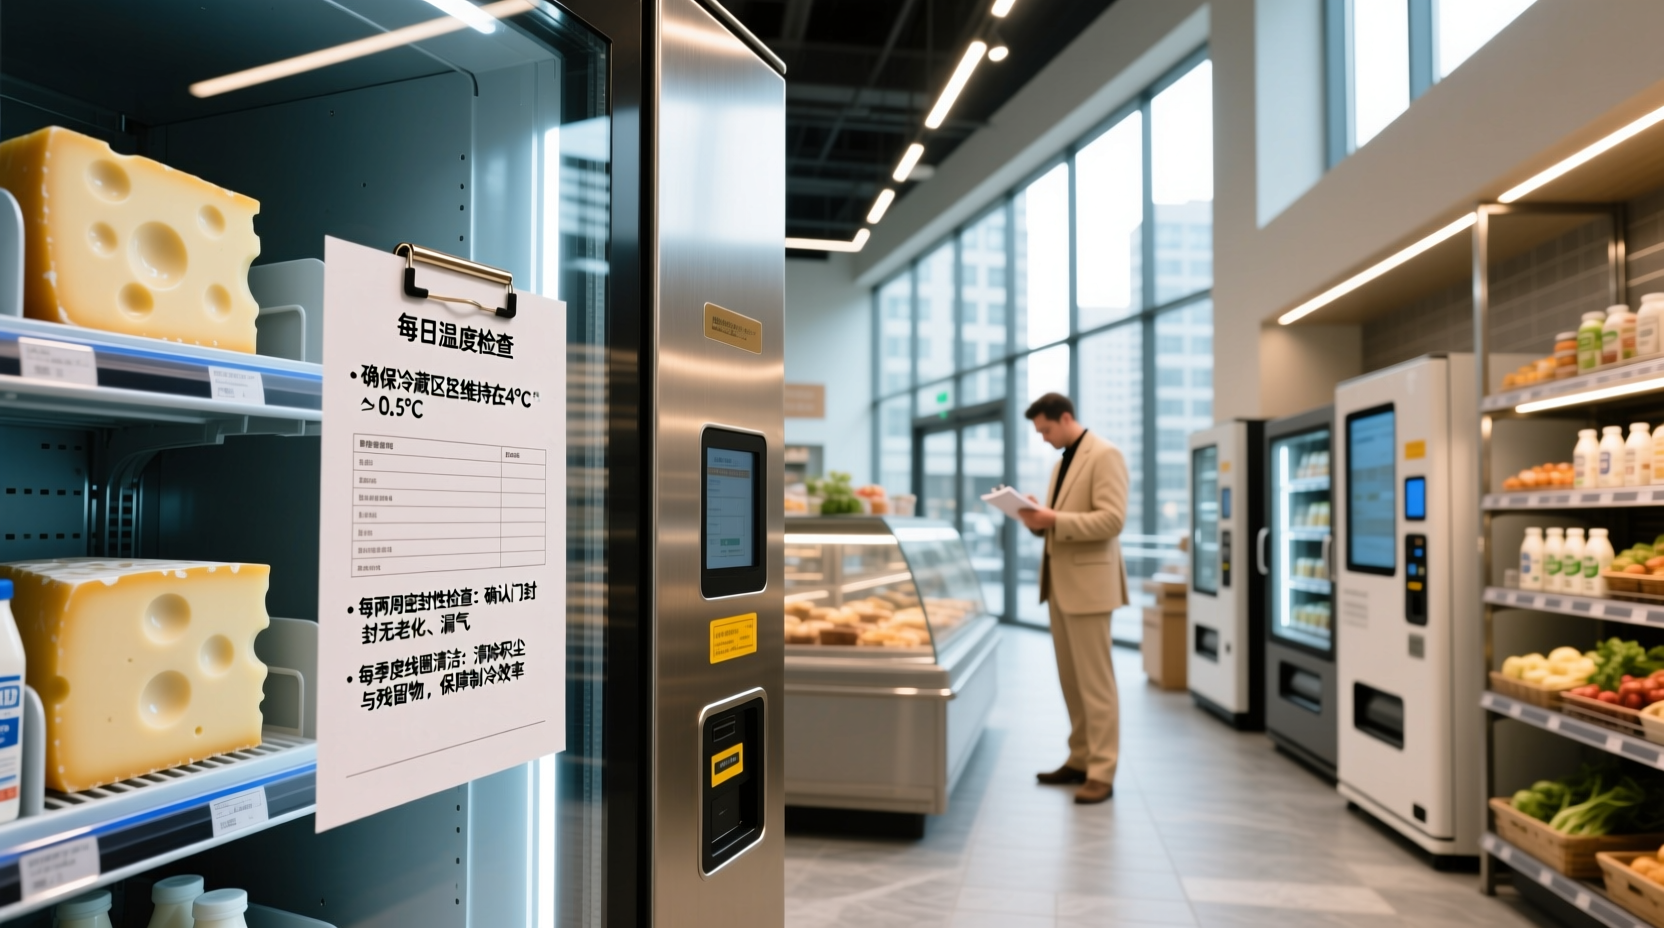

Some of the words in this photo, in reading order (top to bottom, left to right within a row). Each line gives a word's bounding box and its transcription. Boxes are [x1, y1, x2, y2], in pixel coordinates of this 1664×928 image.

[397, 312, 514, 359] 每日温度检查
[362, 612, 470, 644] 封无老化、漏气
